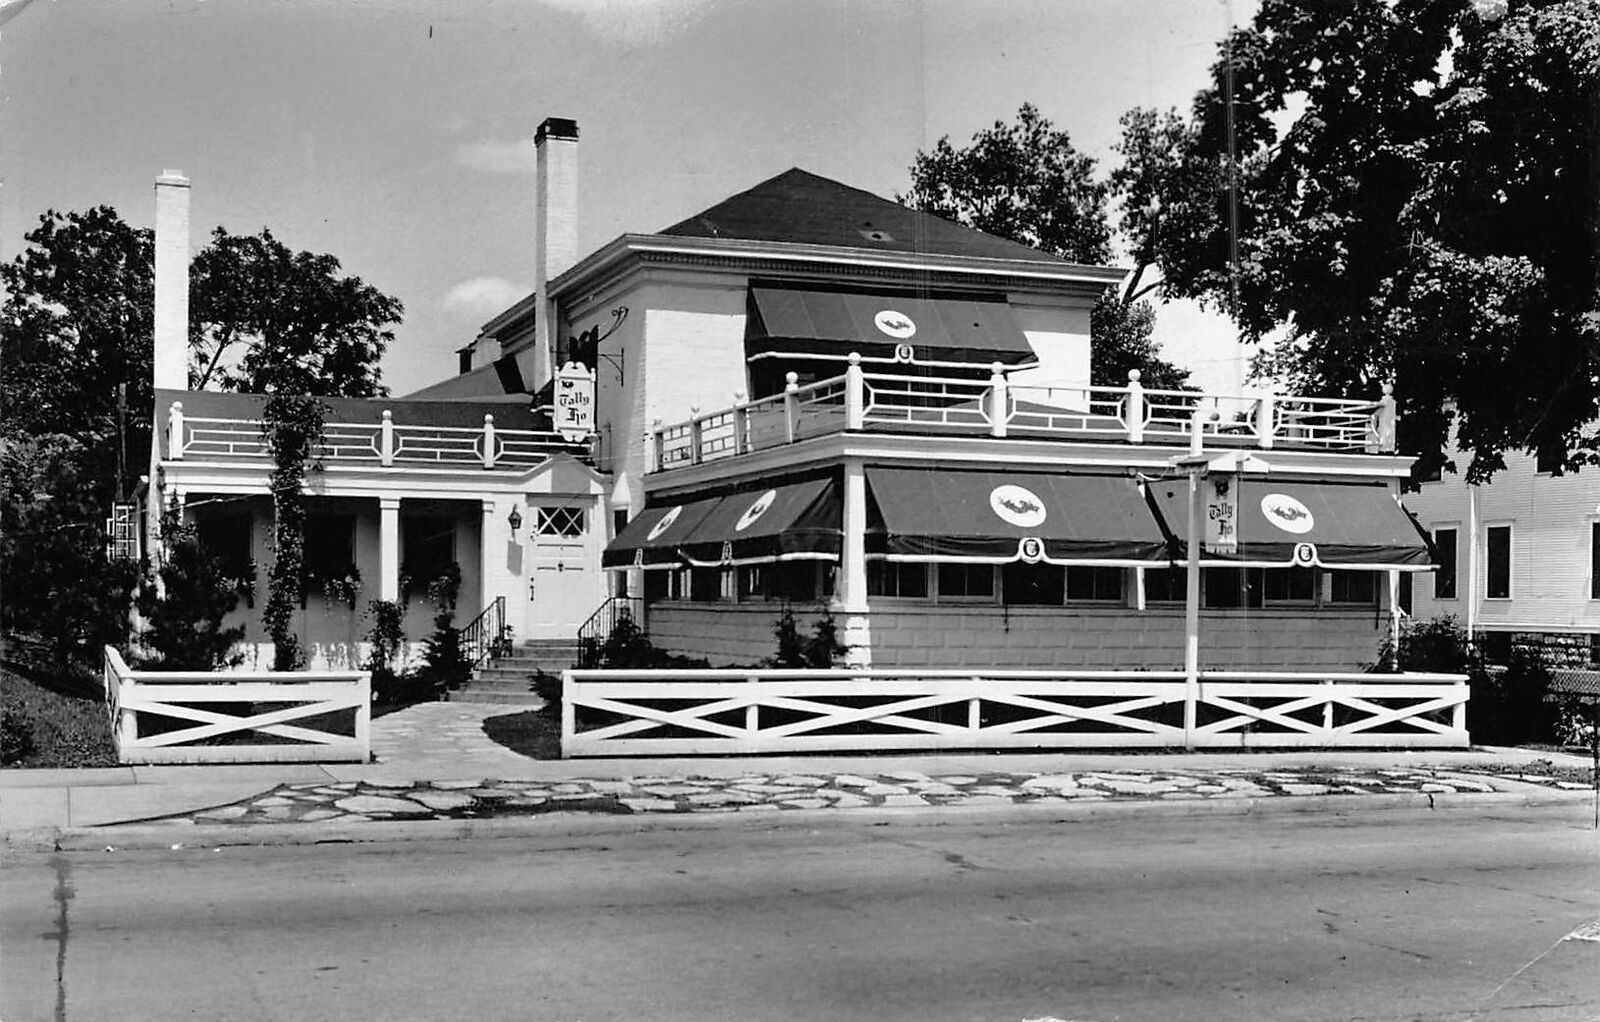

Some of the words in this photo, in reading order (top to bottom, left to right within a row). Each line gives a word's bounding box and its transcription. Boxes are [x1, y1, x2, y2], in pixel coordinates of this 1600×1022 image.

[559, 391, 590, 407] Tally
[566, 407, 587, 425] Ho
[1209, 503, 1233, 520] Tally
[1218, 519, 1233, 538] Ho
